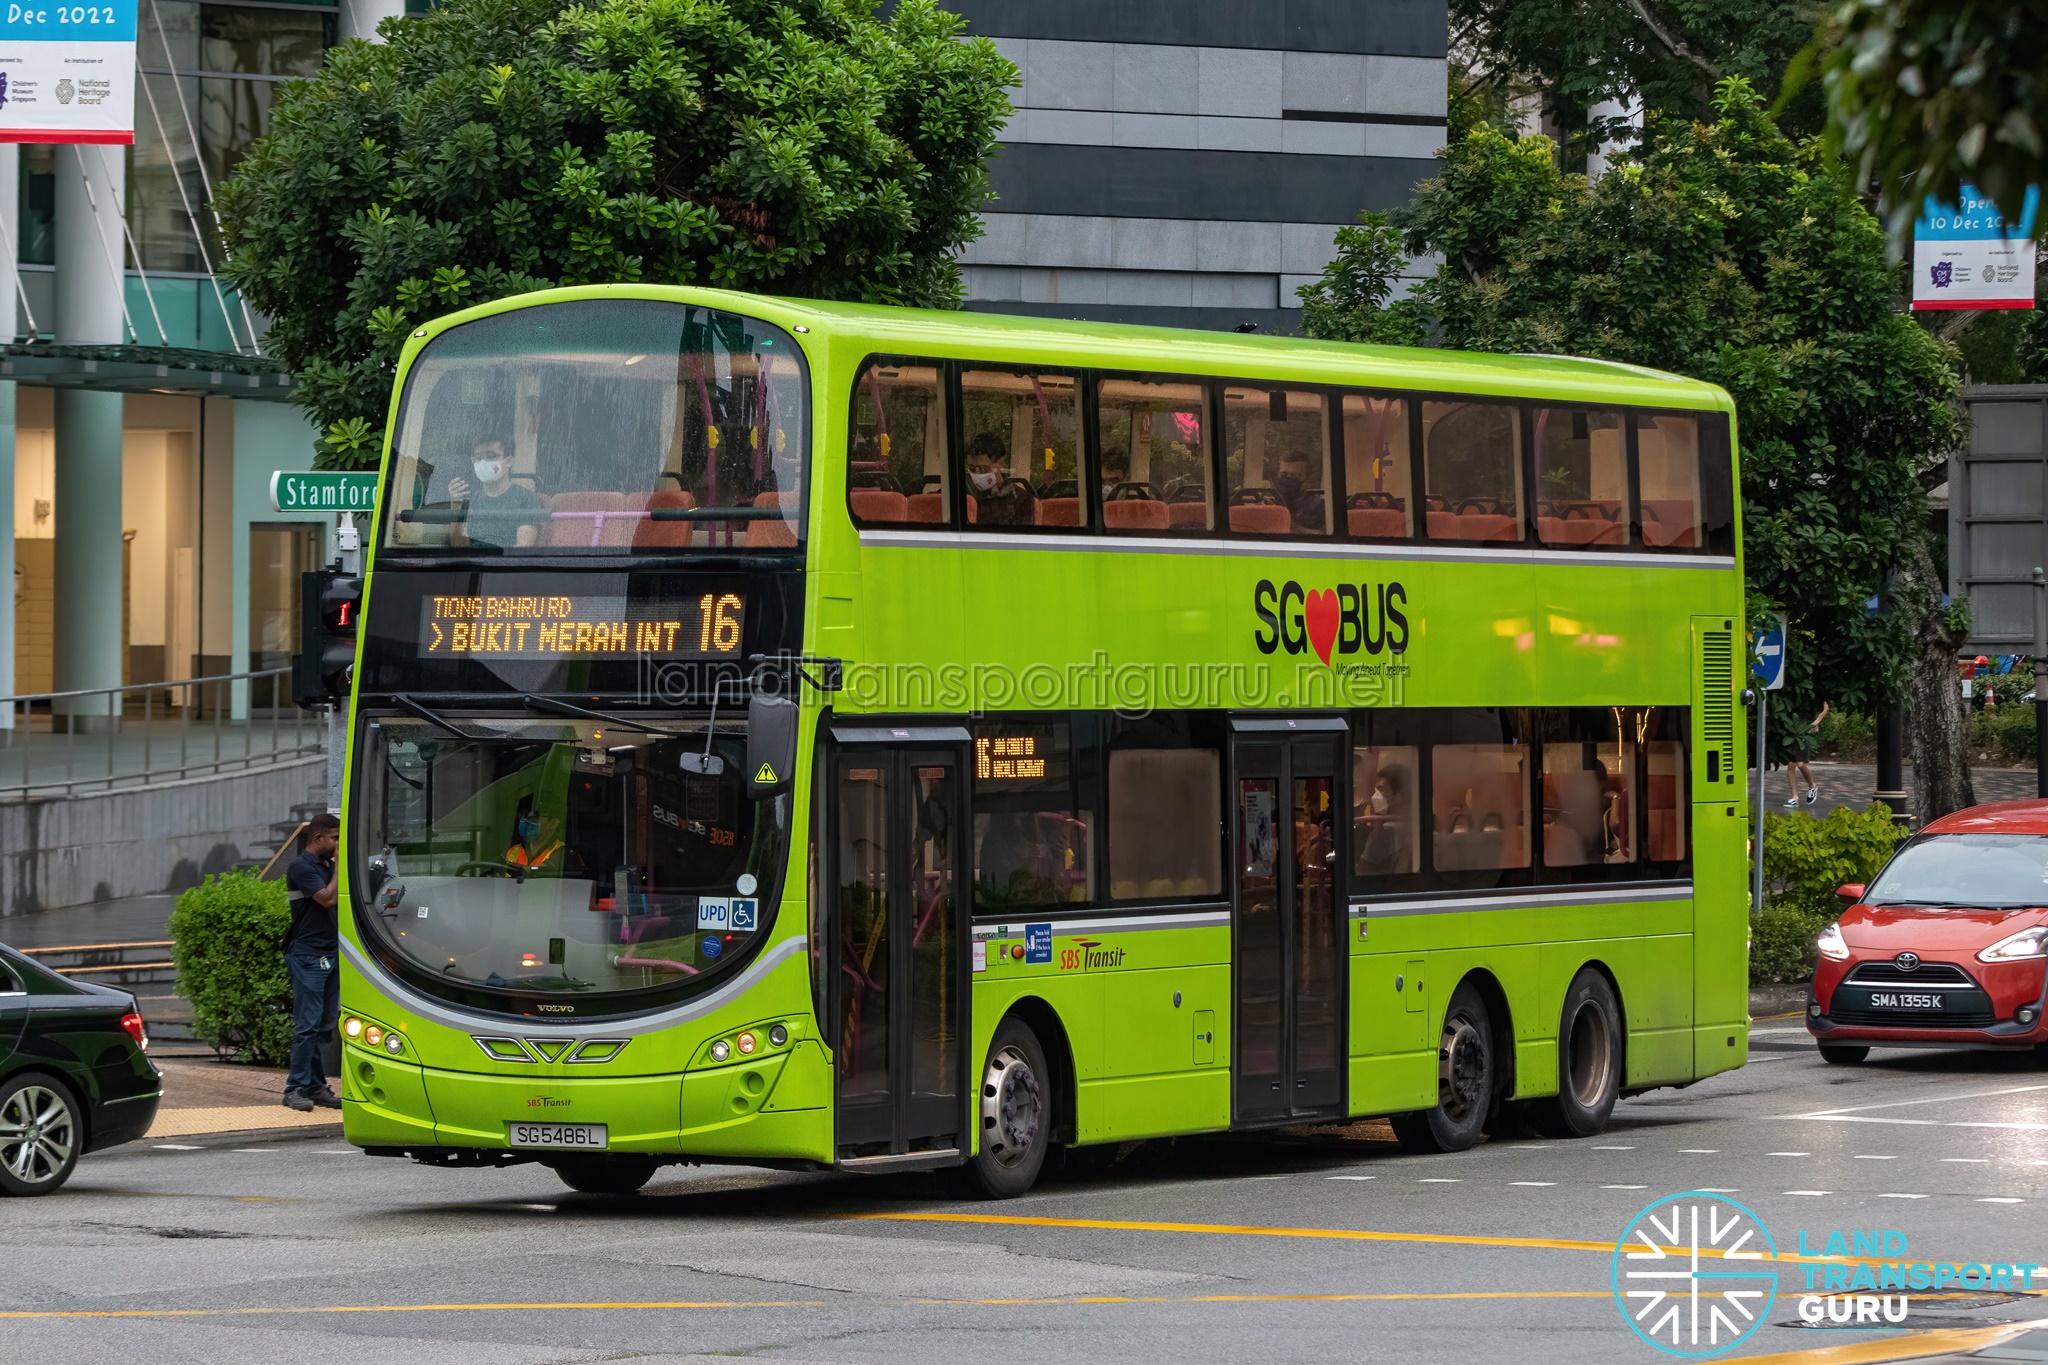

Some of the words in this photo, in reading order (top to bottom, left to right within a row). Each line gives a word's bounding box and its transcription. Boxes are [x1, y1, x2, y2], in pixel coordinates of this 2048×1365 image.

[8, 3, 47, 25] Dec
[57, 7, 116, 24] 2022
[78, 79, 110, 88] National
[78, 88, 111, 98] Heritage
[78, 97, 102, 105] Board
[1931, 217, 1947, 230] 10
[1953, 215, 1979, 230] Dec
[433, 597, 483, 618] TIONG
[486, 597, 544, 618] BAHRU
[547, 597, 573, 618] RD
[699, 594, 742, 652] 16
[451, 622, 532, 652] BUKIT
[538, 622, 629, 652] MERAH
[635, 622, 681, 652] INT
[1335, 662, 1359, 679] Moving
[1360, 662, 1382, 676] Ahead
[1382, 662, 1410, 680] Together
[977, 738, 990, 779] 16
[700, 904, 727, 921] UPD
[1060, 949, 1080, 970] SBS
[1079, 942, 1127, 972] Transit
[537, 1004, 575, 1013] VOLVO
[527, 1099, 541, 1107] SBS
[541, 1097, 573, 1108] Transit
[517, 1127, 599, 1145] SG5486L
